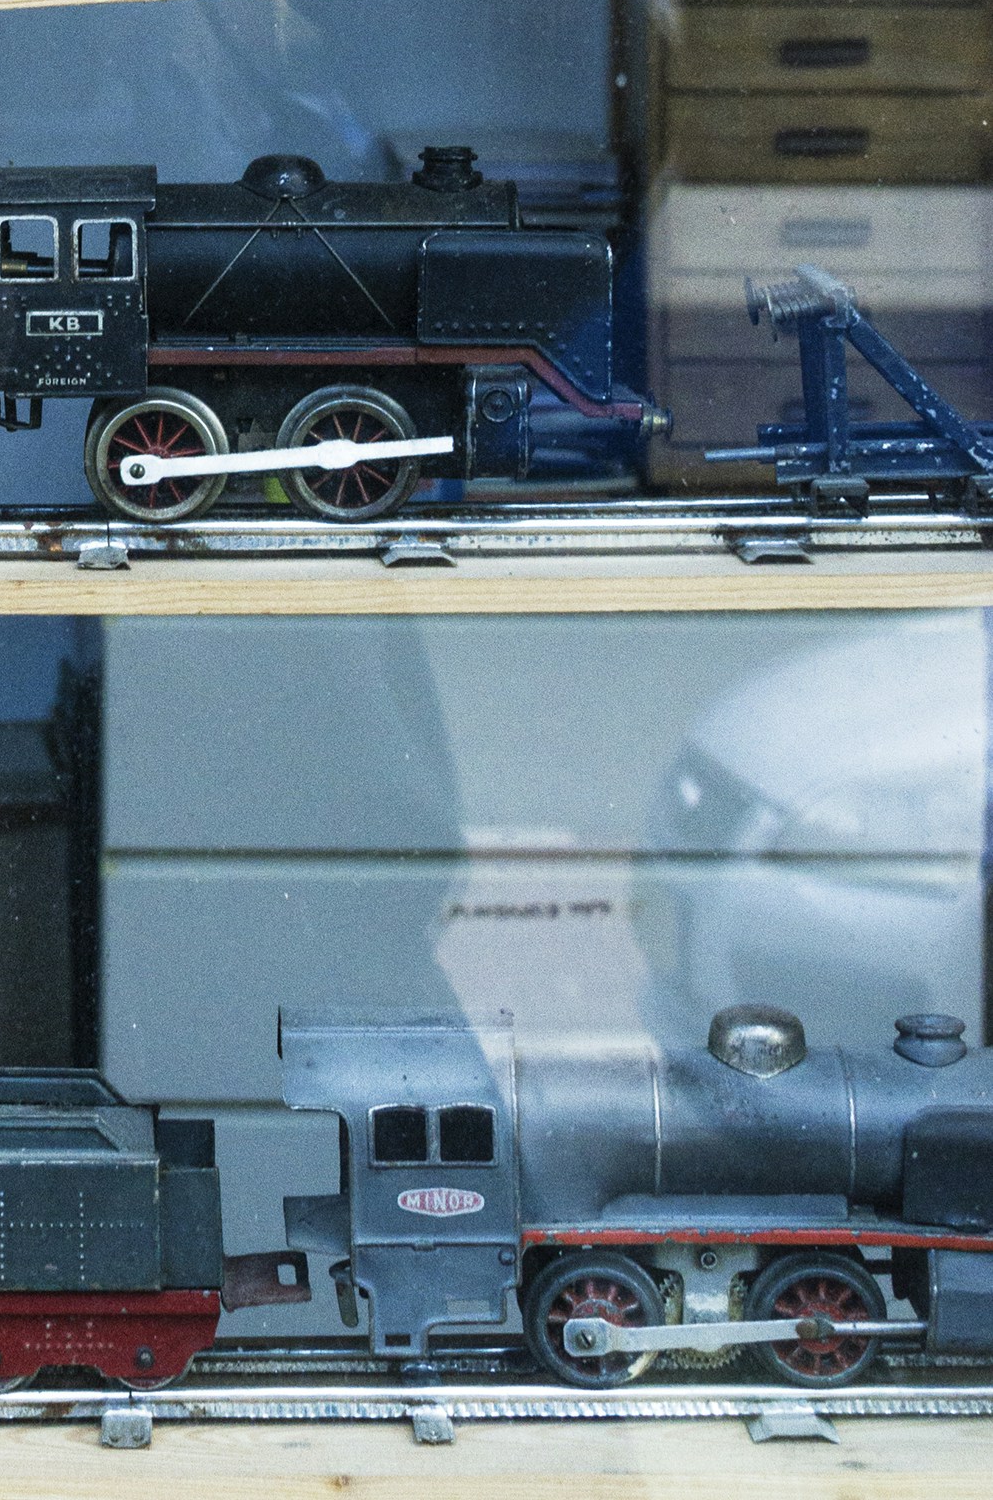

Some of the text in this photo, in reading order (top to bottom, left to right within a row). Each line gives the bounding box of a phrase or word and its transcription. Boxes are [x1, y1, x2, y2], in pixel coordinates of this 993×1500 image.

[48, 316, 81, 332] KB
[37, 376, 87, 387] FOREIGN
[406, 1192, 473, 1211] MINOR
